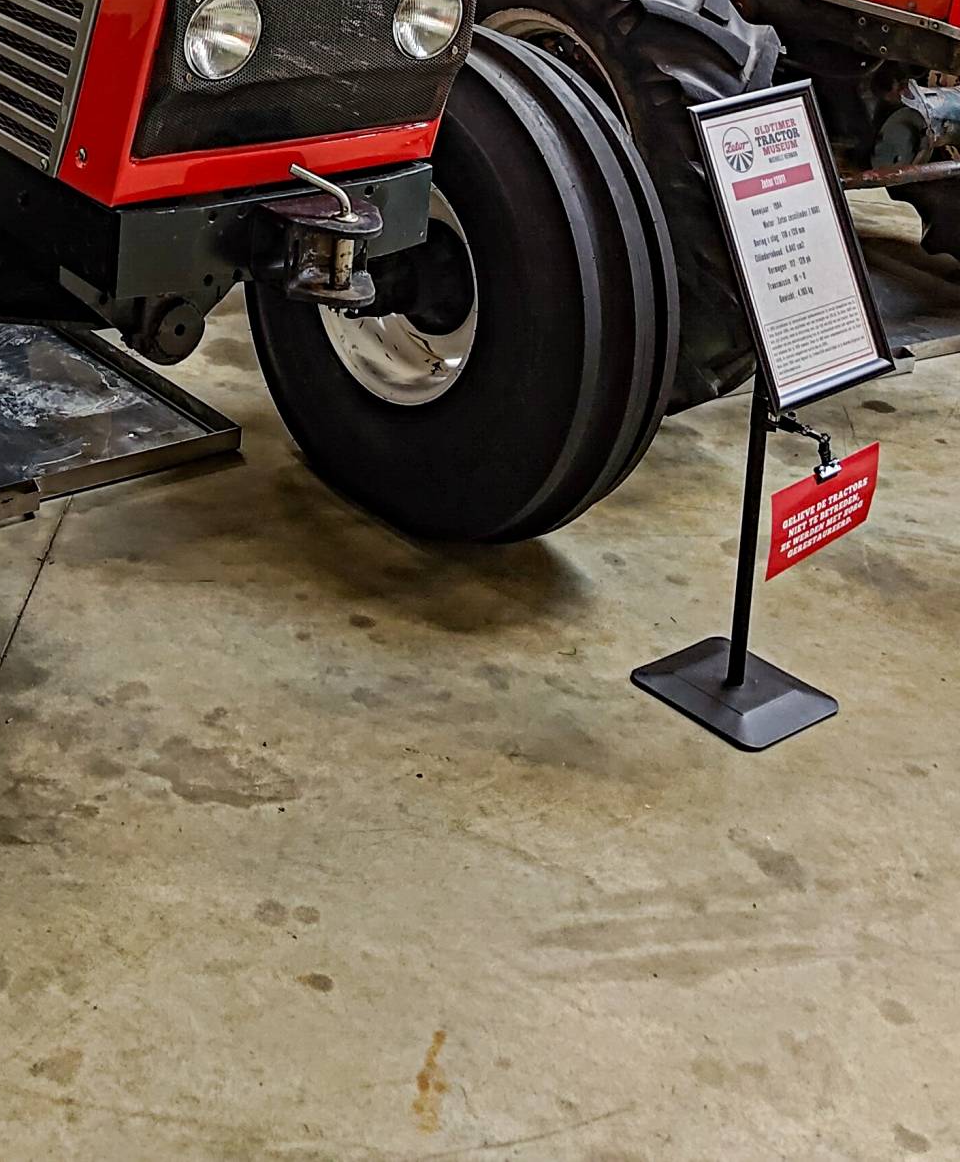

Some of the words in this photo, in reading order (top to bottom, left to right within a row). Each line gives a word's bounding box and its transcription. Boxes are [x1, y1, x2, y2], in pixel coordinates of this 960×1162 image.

[754, 118, 797, 135] OLDTIMER
[755, 128, 800, 147] TRACTOR
[762, 140, 798, 156] MUSEUM
[782, 505, 816, 529] GELIEVE
[816, 499, 827, 511] DE
[828, 477, 868, 503] TRACTORS
[788, 521, 807, 538] NIET
